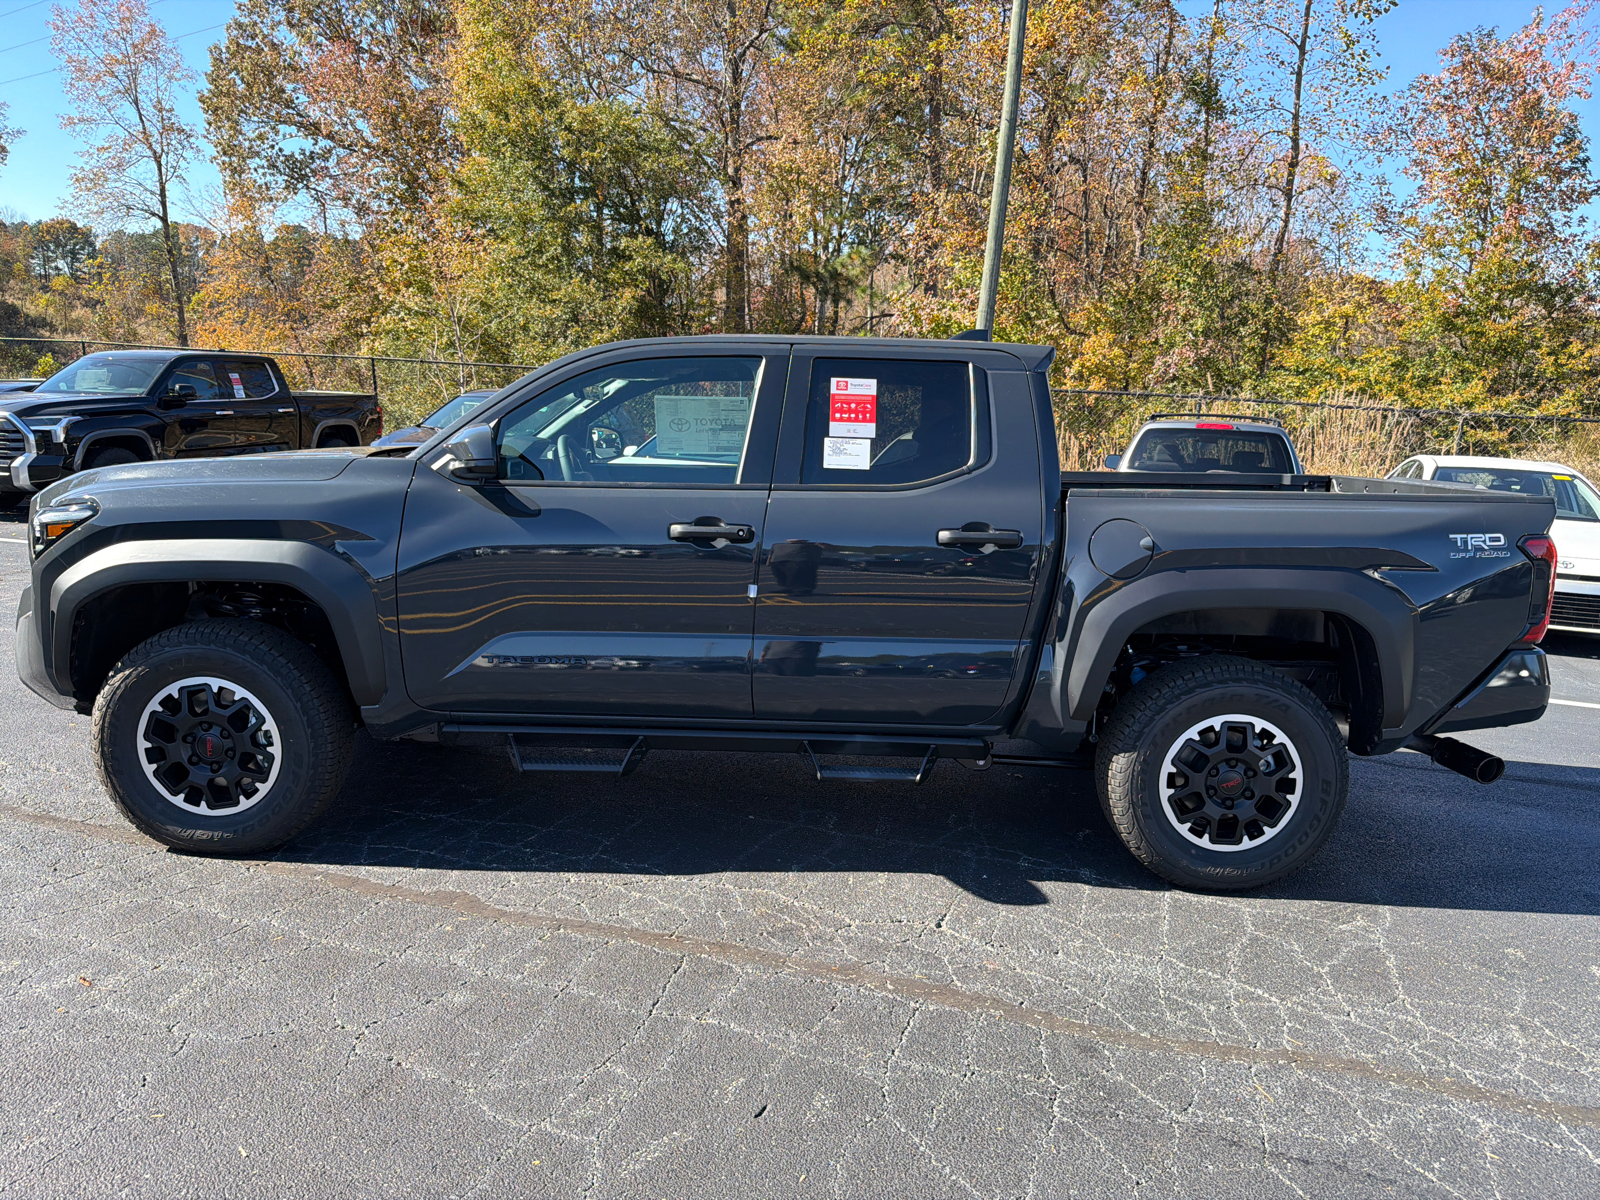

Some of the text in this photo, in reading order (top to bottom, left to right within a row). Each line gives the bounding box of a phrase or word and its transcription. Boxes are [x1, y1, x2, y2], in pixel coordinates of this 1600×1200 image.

[693, 417, 736, 427] TOYOTA
[1449, 533, 1506, 550] TRD
[1450, 550, 1511, 559] OFF ROAD
[481, 655, 588, 665] TACOMA
